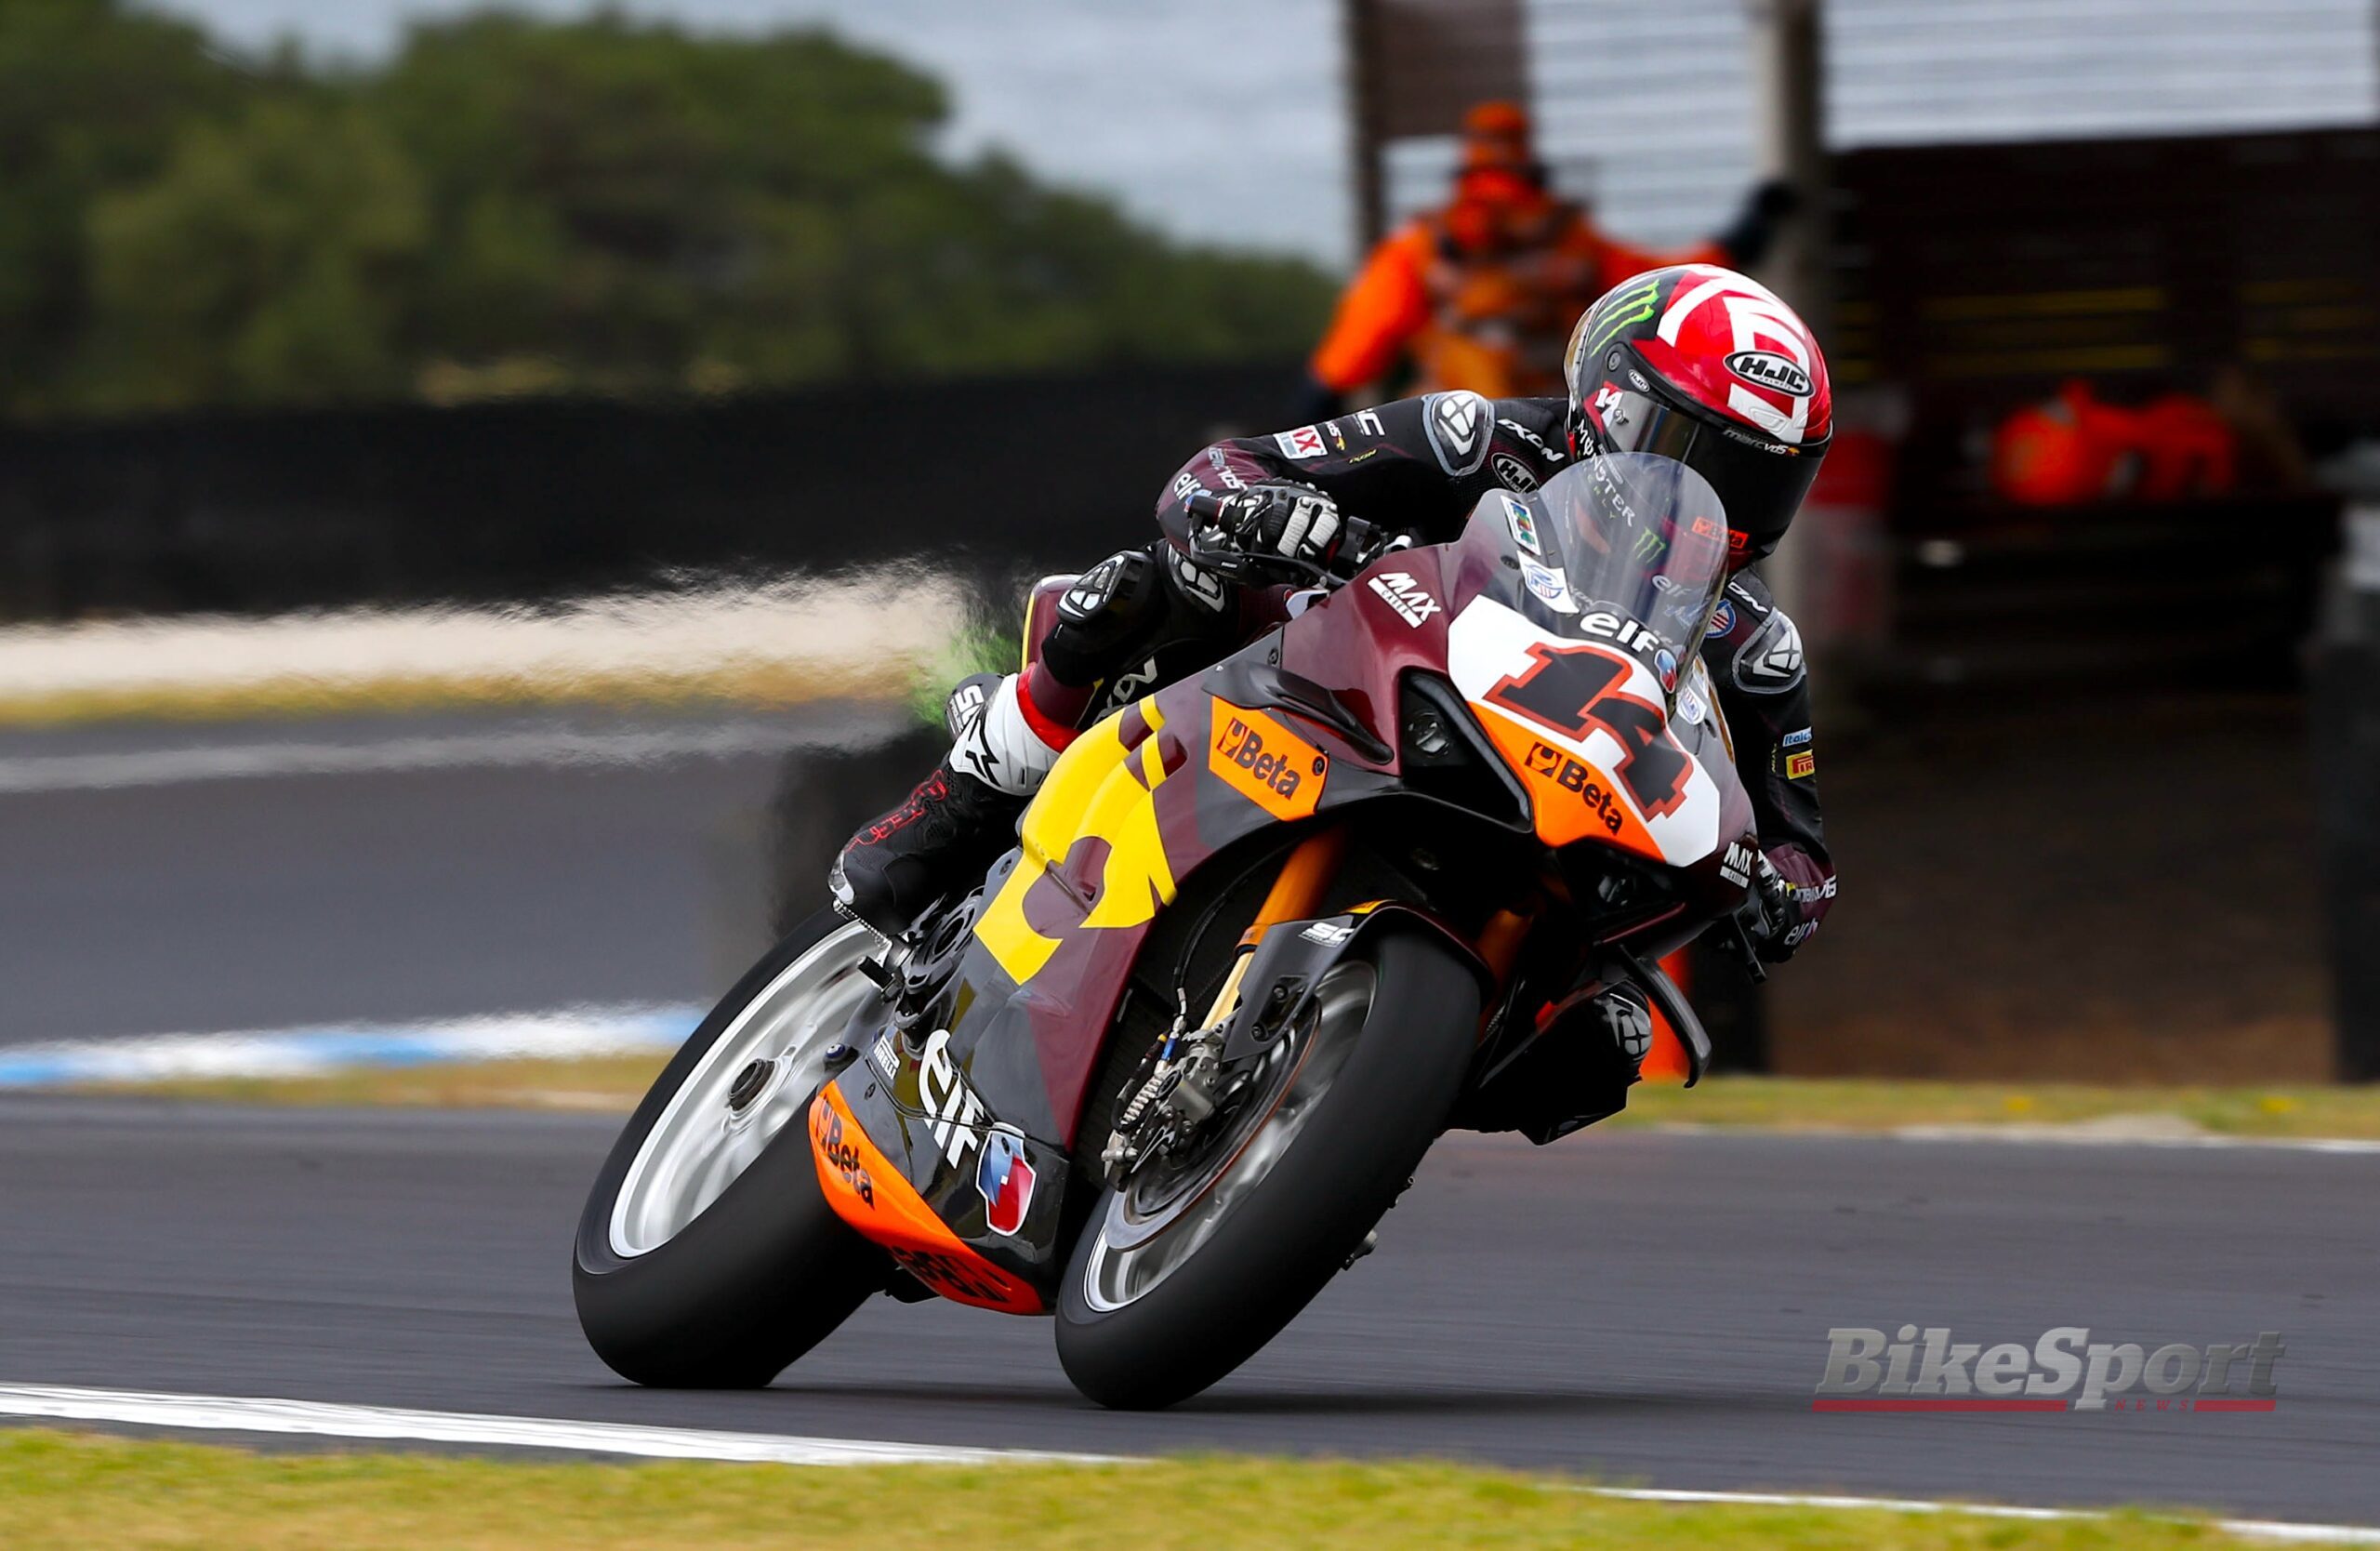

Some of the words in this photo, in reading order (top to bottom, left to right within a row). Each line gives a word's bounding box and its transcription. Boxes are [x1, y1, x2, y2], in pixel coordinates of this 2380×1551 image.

[1739, 356, 1806, 391] HJC
[1173, 472, 1203, 501] elf
[1378, 572, 1441, 622] MAX
[1580, 612, 1659, 653] elf
[1483, 642, 1693, 823] 14
[1234, 729, 1302, 801] Beta
[1556, 759, 1624, 835] Beta
[1723, 841, 1753, 876] MAX
[1303, 921, 1355, 942] SC
[873, 1034, 901, 1080] PIRELLI
[918, 1028, 988, 1170] elf
[821, 1109, 876, 1212] Beta
